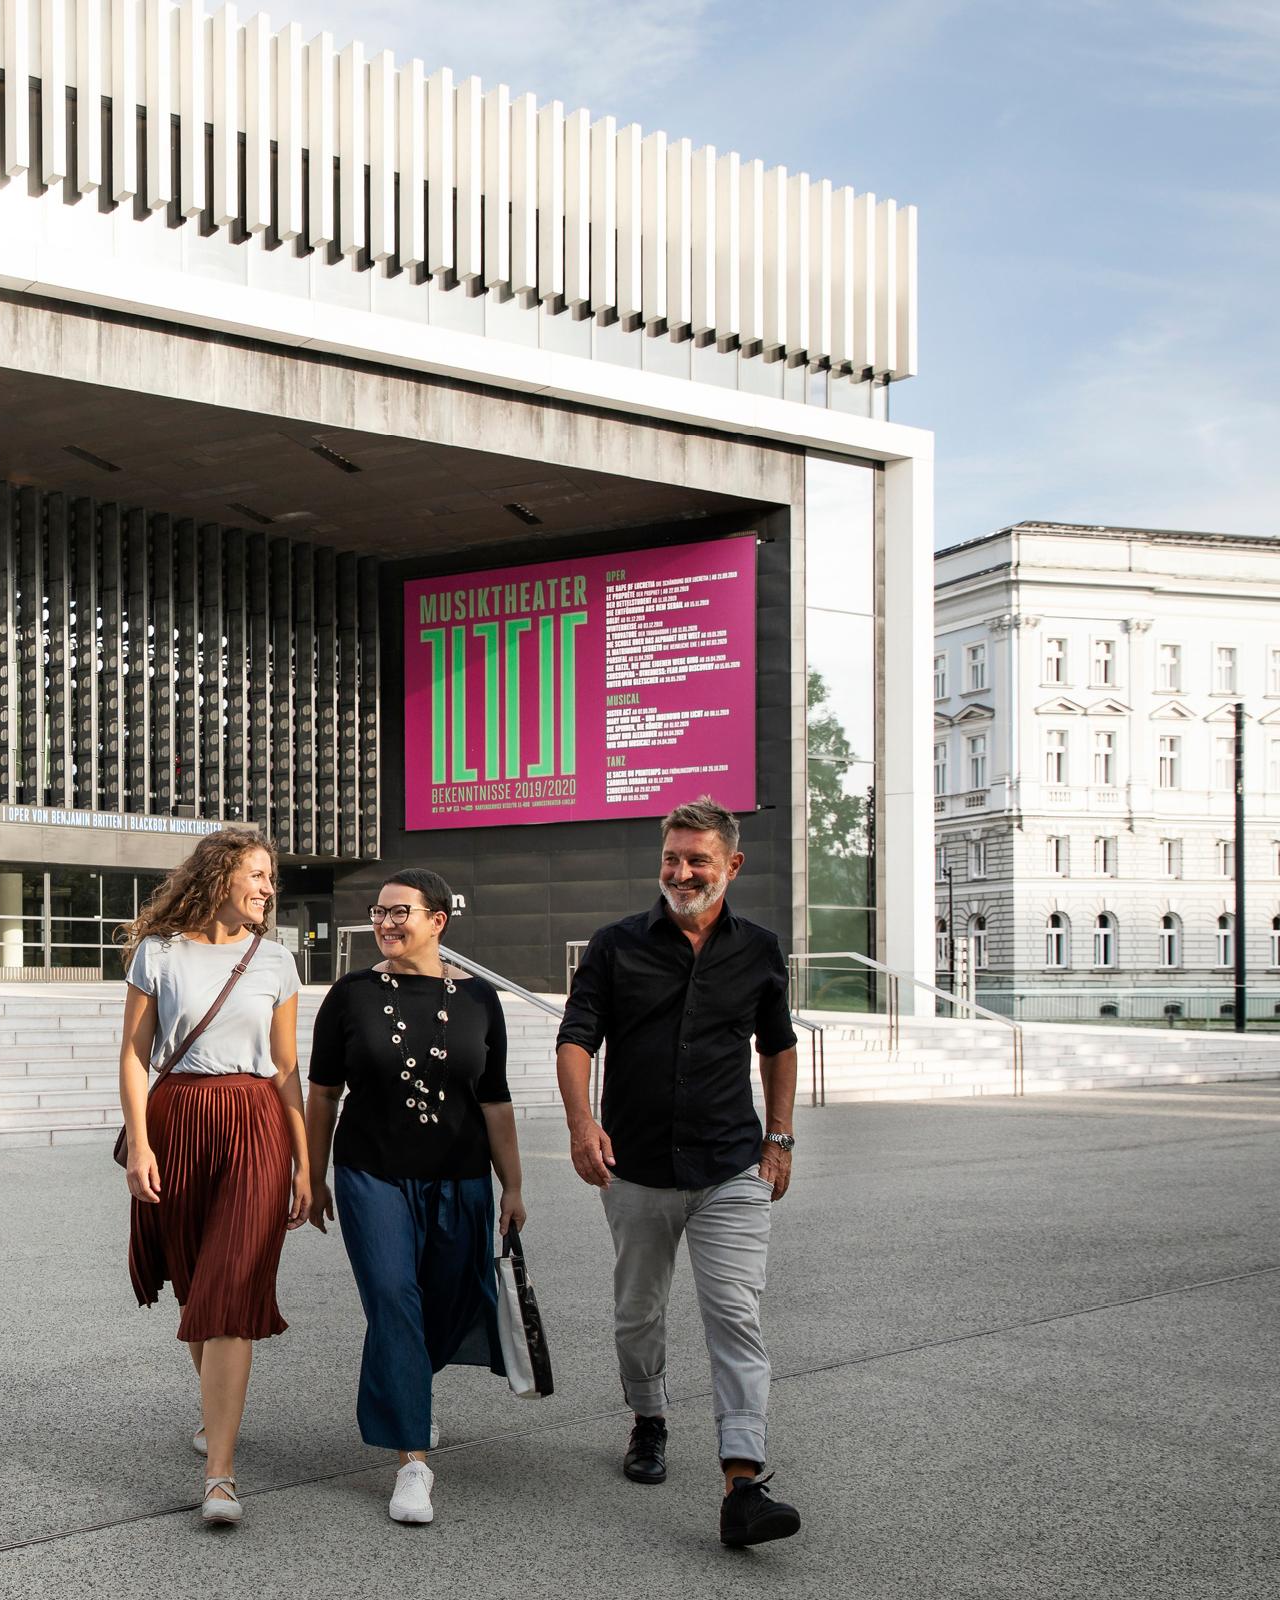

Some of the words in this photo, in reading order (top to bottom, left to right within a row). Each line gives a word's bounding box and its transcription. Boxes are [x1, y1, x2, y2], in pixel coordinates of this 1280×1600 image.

[606, 570, 626, 582] OPER
[420, 576, 587, 624] MUSIKTHEATER
[606, 693, 640, 706] MUSICAL
[607, 756, 626, 767] TANZ
[432, 783, 511, 804] BEKENNTNISSE
[515, 778, 576, 799] 2019/2020
[8, 806, 29, 822] OPER
[32, 808, 49, 823] VON
[51, 810, 90, 826] BENJAMIN
[92, 813, 122, 829] BRITTEN
[130, 816, 167, 832] BLACKBOX
[170, 820, 222, 835] MUSIKTHEATER
